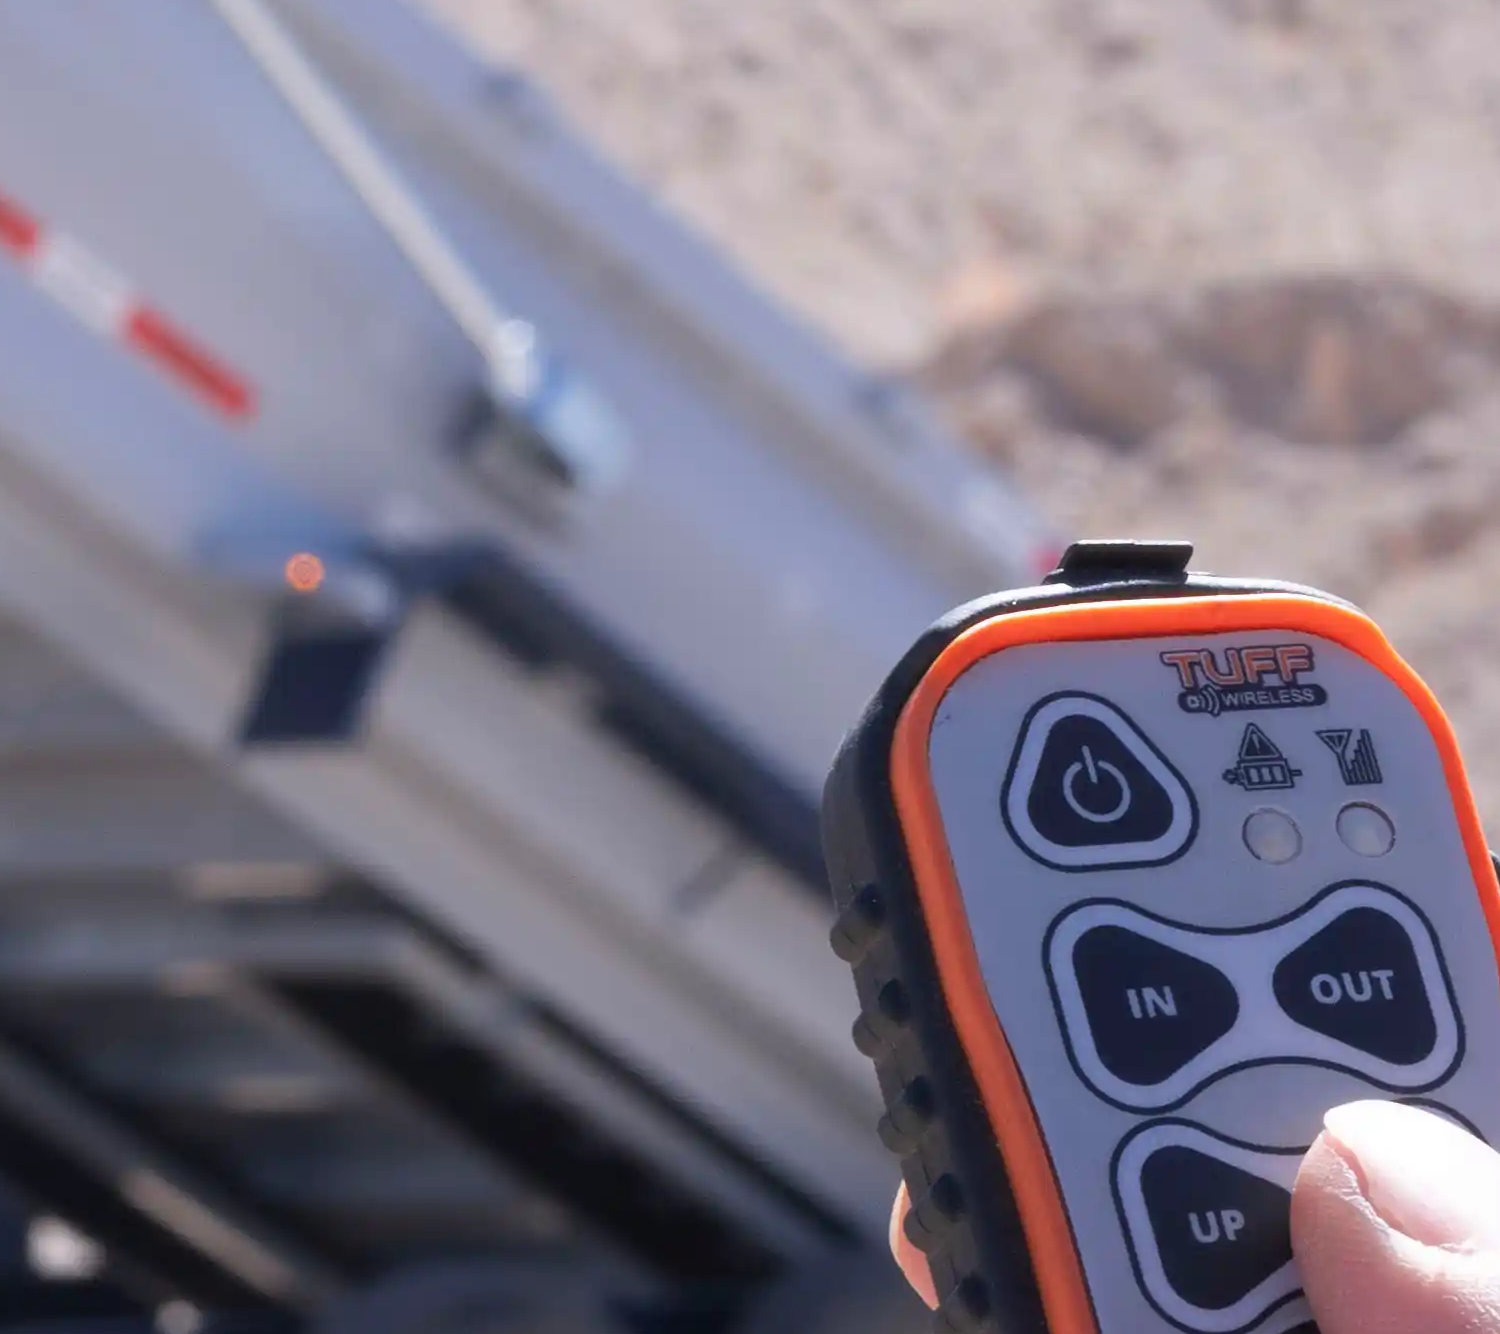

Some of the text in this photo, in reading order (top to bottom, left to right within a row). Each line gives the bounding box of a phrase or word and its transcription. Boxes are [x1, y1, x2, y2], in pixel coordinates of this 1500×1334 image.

[1161, 644, 1315, 688] TUFF
[1221, 687, 1316, 707] WIRELESS
[1126, 985, 1178, 1019] IN
[1310, 969, 1395, 1005] OUT
[1188, 1208, 1246, 1244] UP
